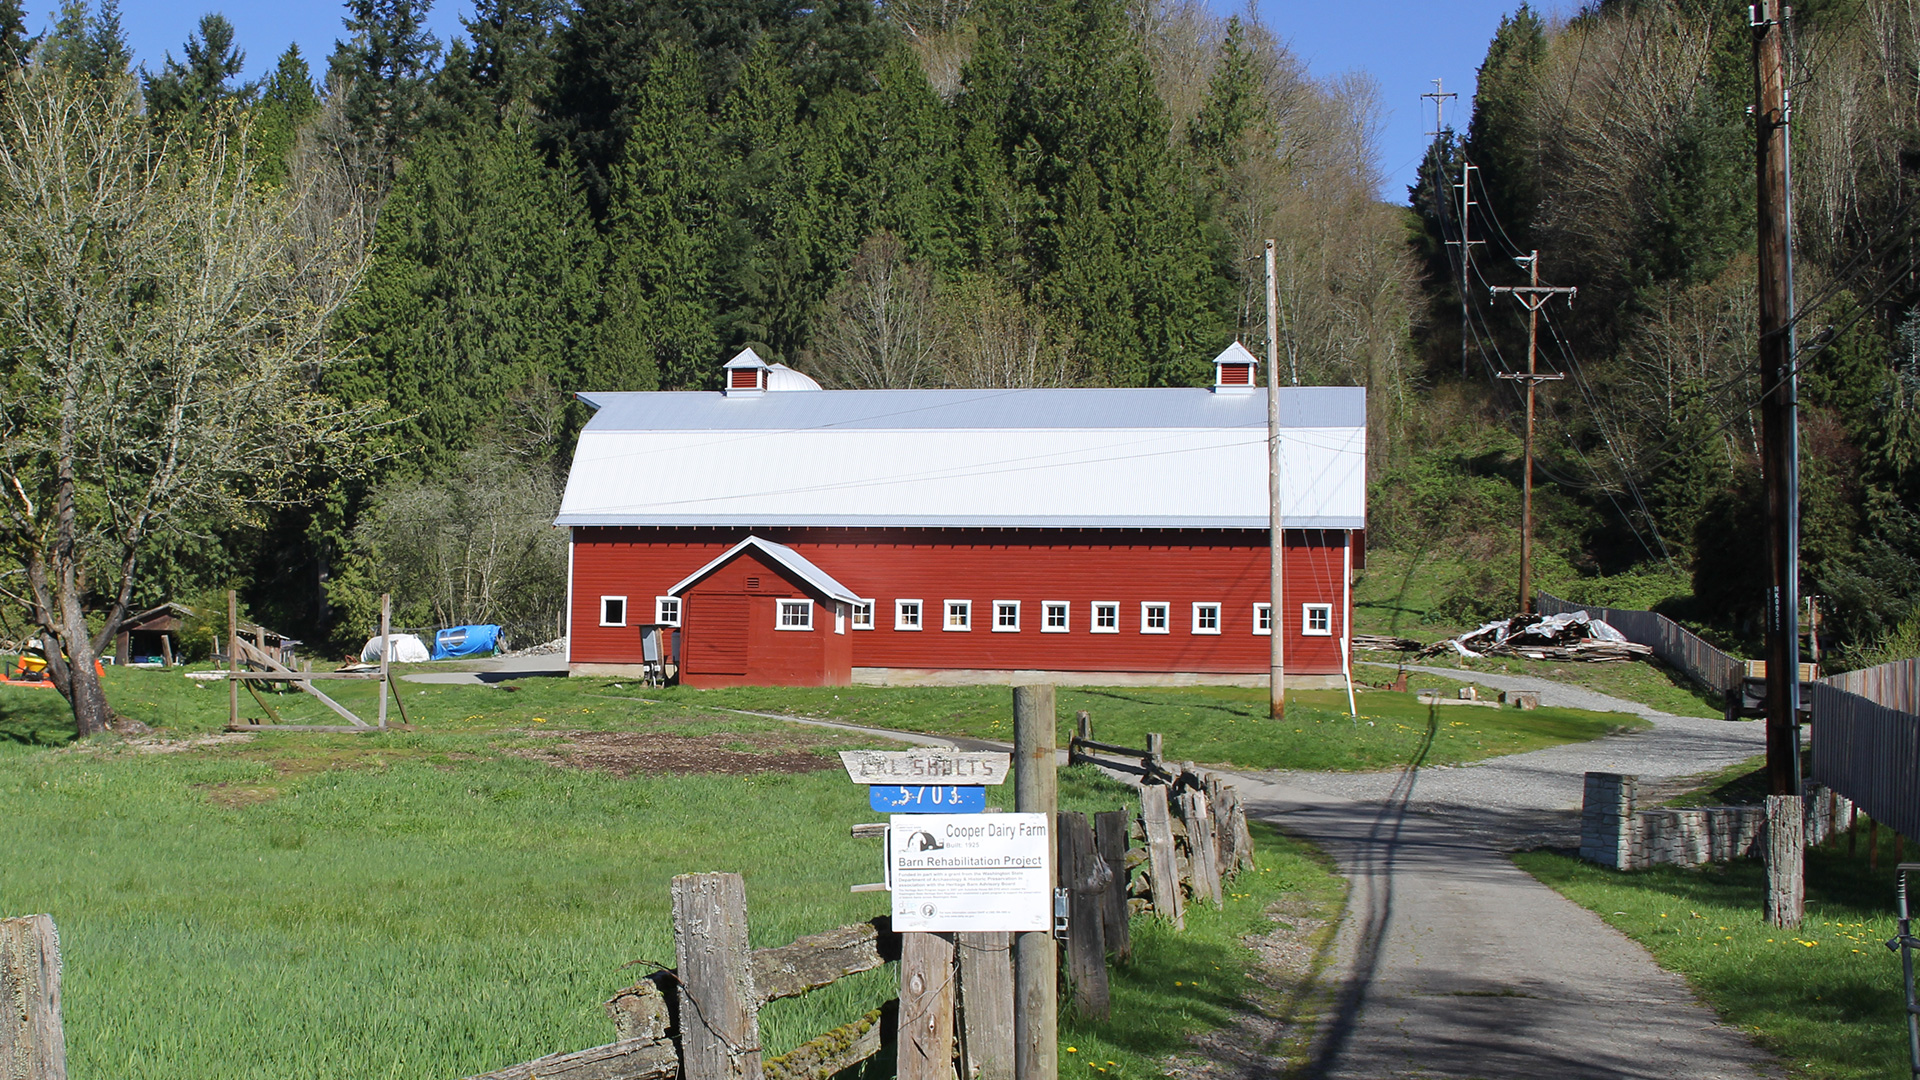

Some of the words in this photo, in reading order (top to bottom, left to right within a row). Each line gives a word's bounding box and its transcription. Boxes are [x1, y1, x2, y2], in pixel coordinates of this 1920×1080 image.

[945, 823, 985, 840] Cooper
[988, 823, 1016, 840] Dairy
[1019, 822, 1047, 837] Farm
[898, 857, 924, 867] Barn
[927, 856, 1001, 867] Rehabilitation
[1003, 855, 1042, 868] Project
